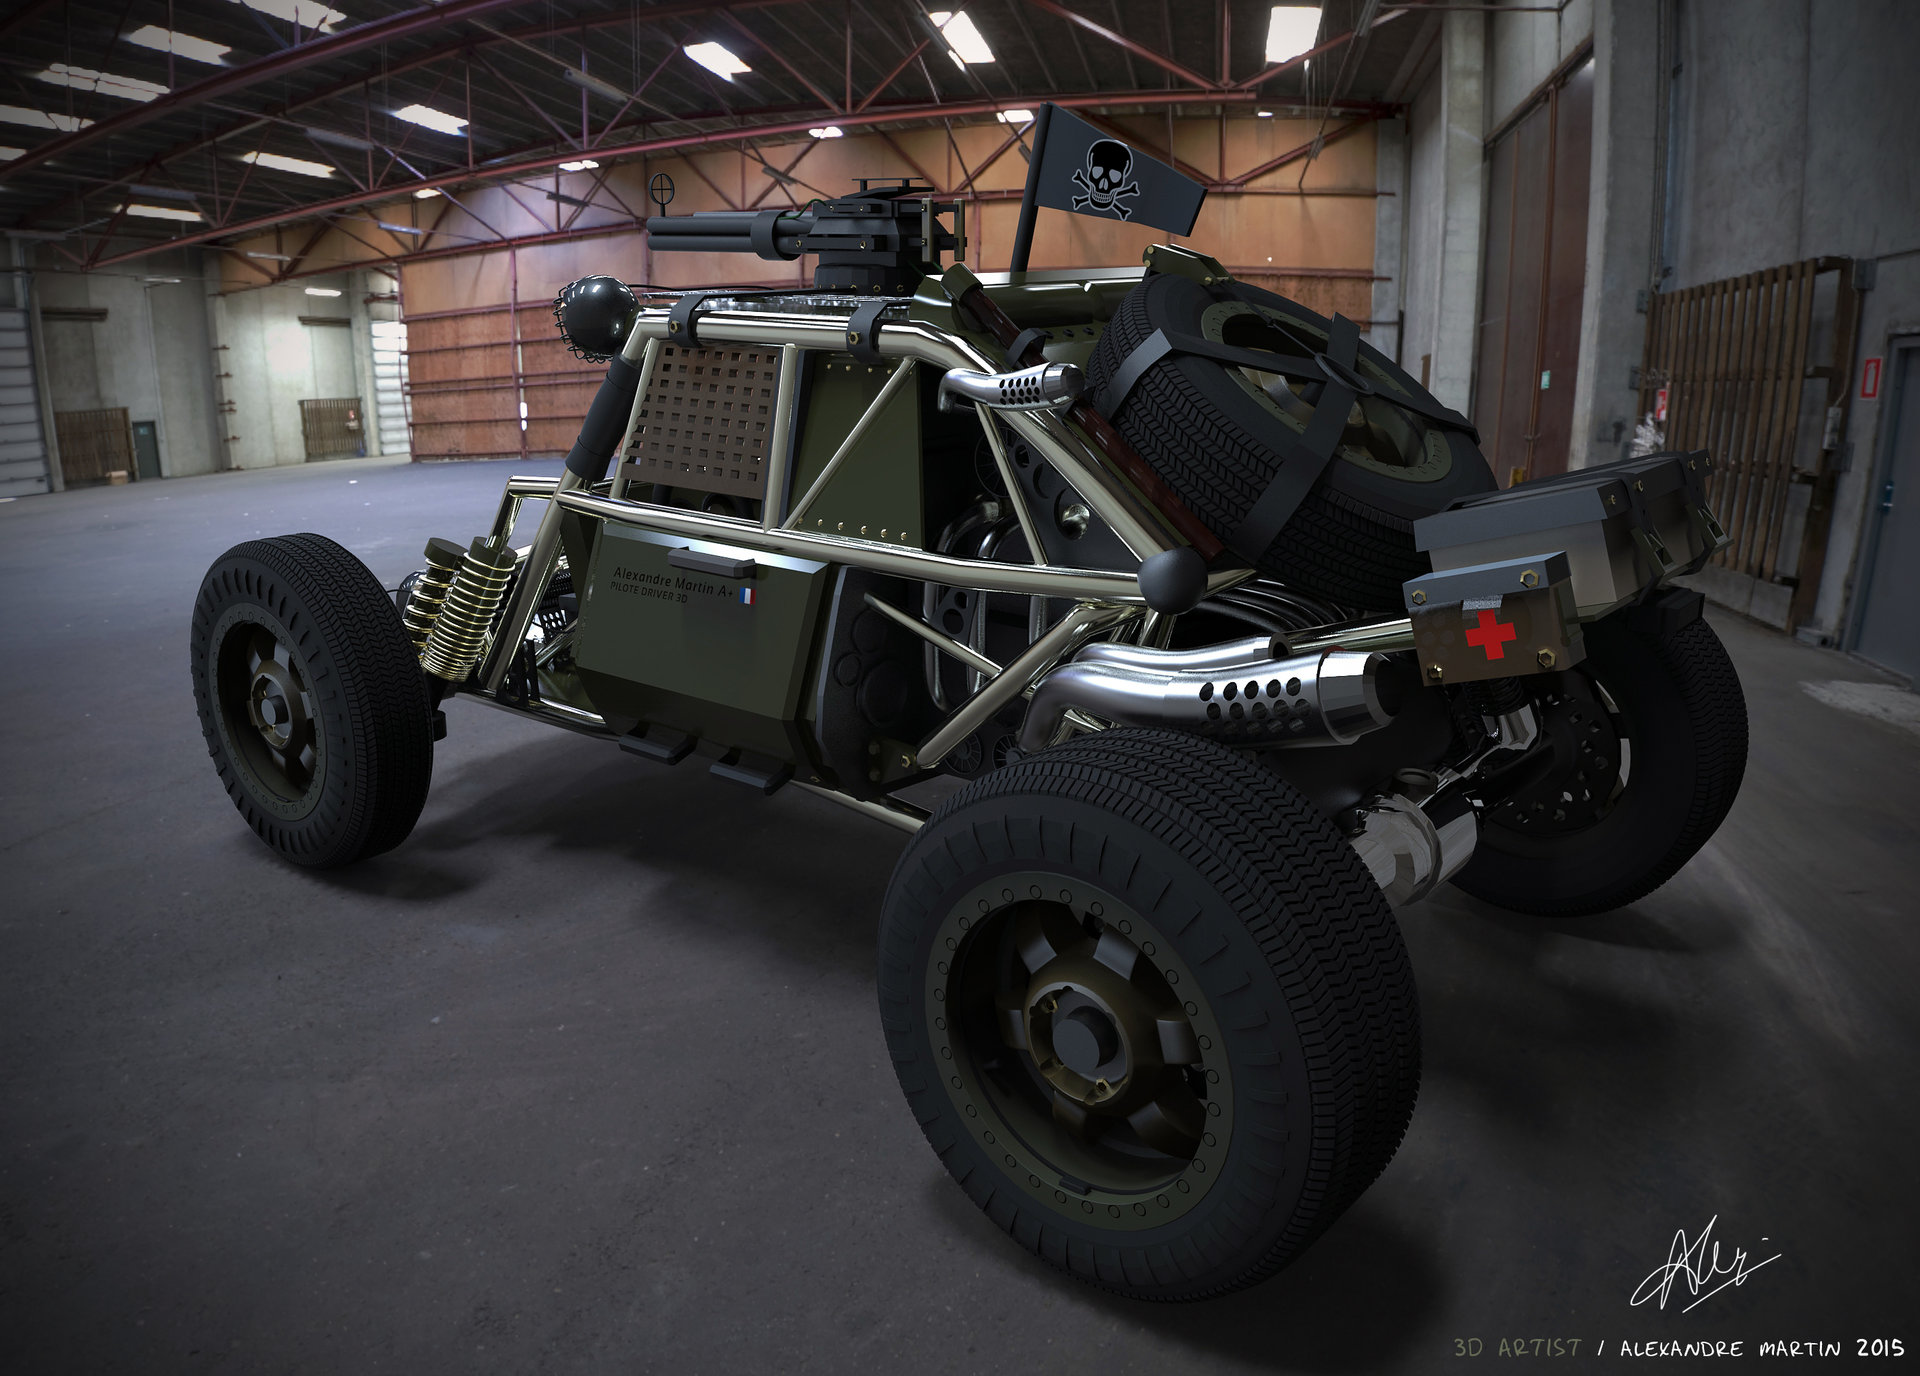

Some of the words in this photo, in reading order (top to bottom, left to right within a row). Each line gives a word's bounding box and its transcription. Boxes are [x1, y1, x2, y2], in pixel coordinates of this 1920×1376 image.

[611, 581, 638, 594] PILOTE
[641, 586, 673, 601] DRIVER
[675, 593, 688, 604] 3D
[613, 567, 671, 586] Alexandre
[675, 577, 714, 595] Martin
